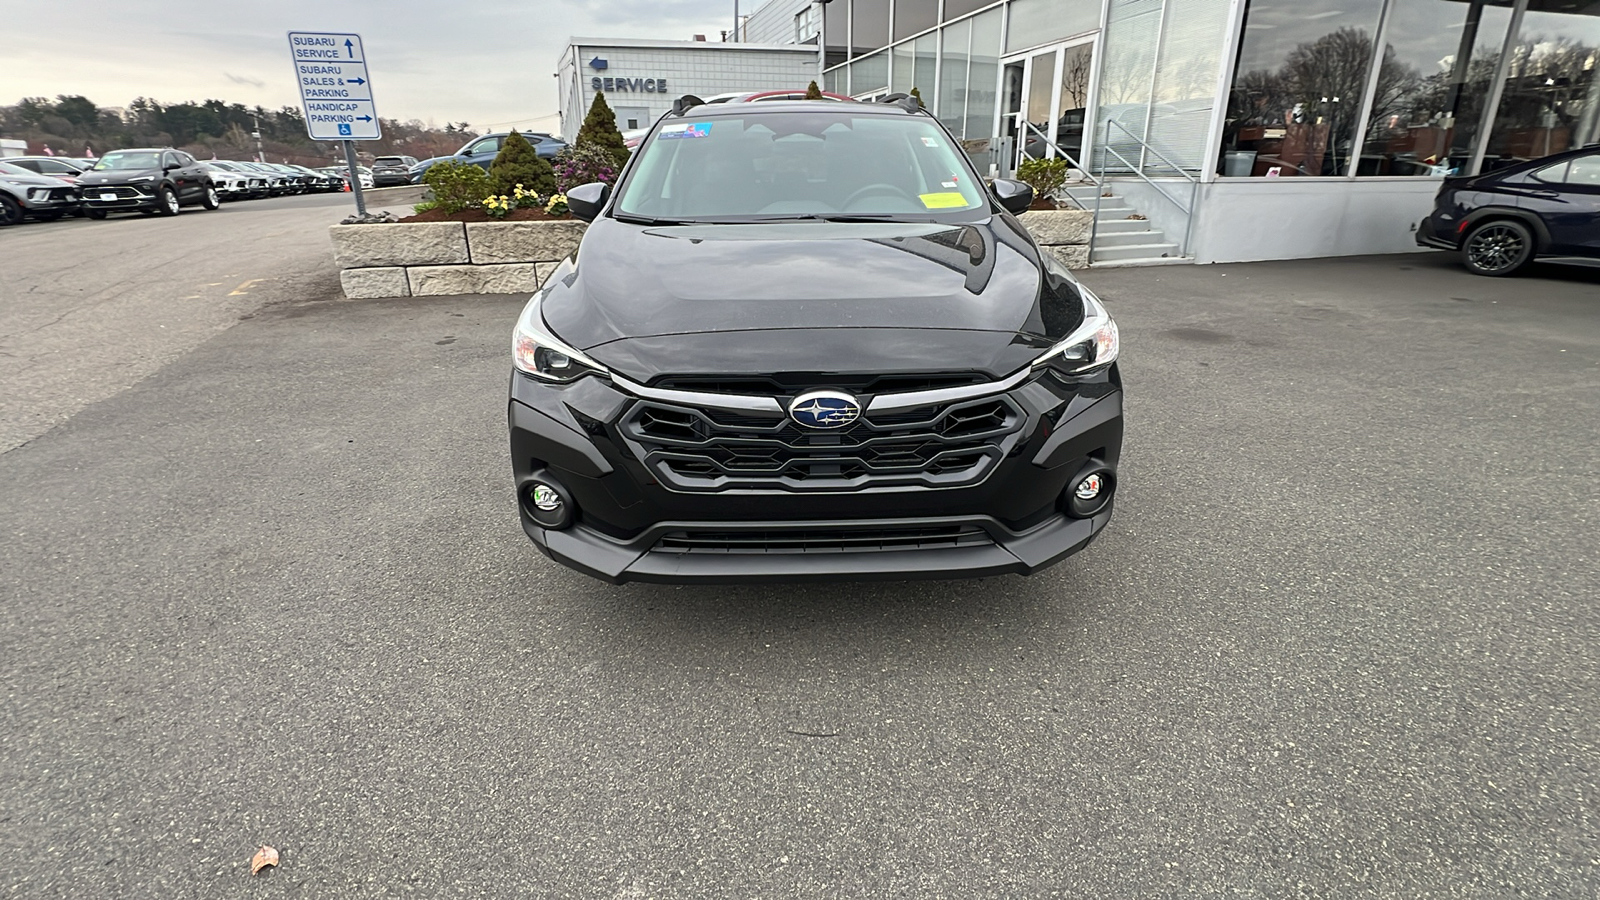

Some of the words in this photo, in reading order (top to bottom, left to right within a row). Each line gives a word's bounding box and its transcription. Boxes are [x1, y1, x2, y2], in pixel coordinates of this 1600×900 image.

[293, 37, 335, 46] SUBARU
[296, 49, 339, 58] SERVICE
[300, 66, 341, 74] SUBARU
[302, 77, 335, 86] SALES
[337, 78, 345, 86] &
[591, 77, 667, 93] SERVICE
[305, 89, 349, 97] PARKING
[308, 103, 358, 111] HANDICAP
[311, 114, 354, 123] PARKING
